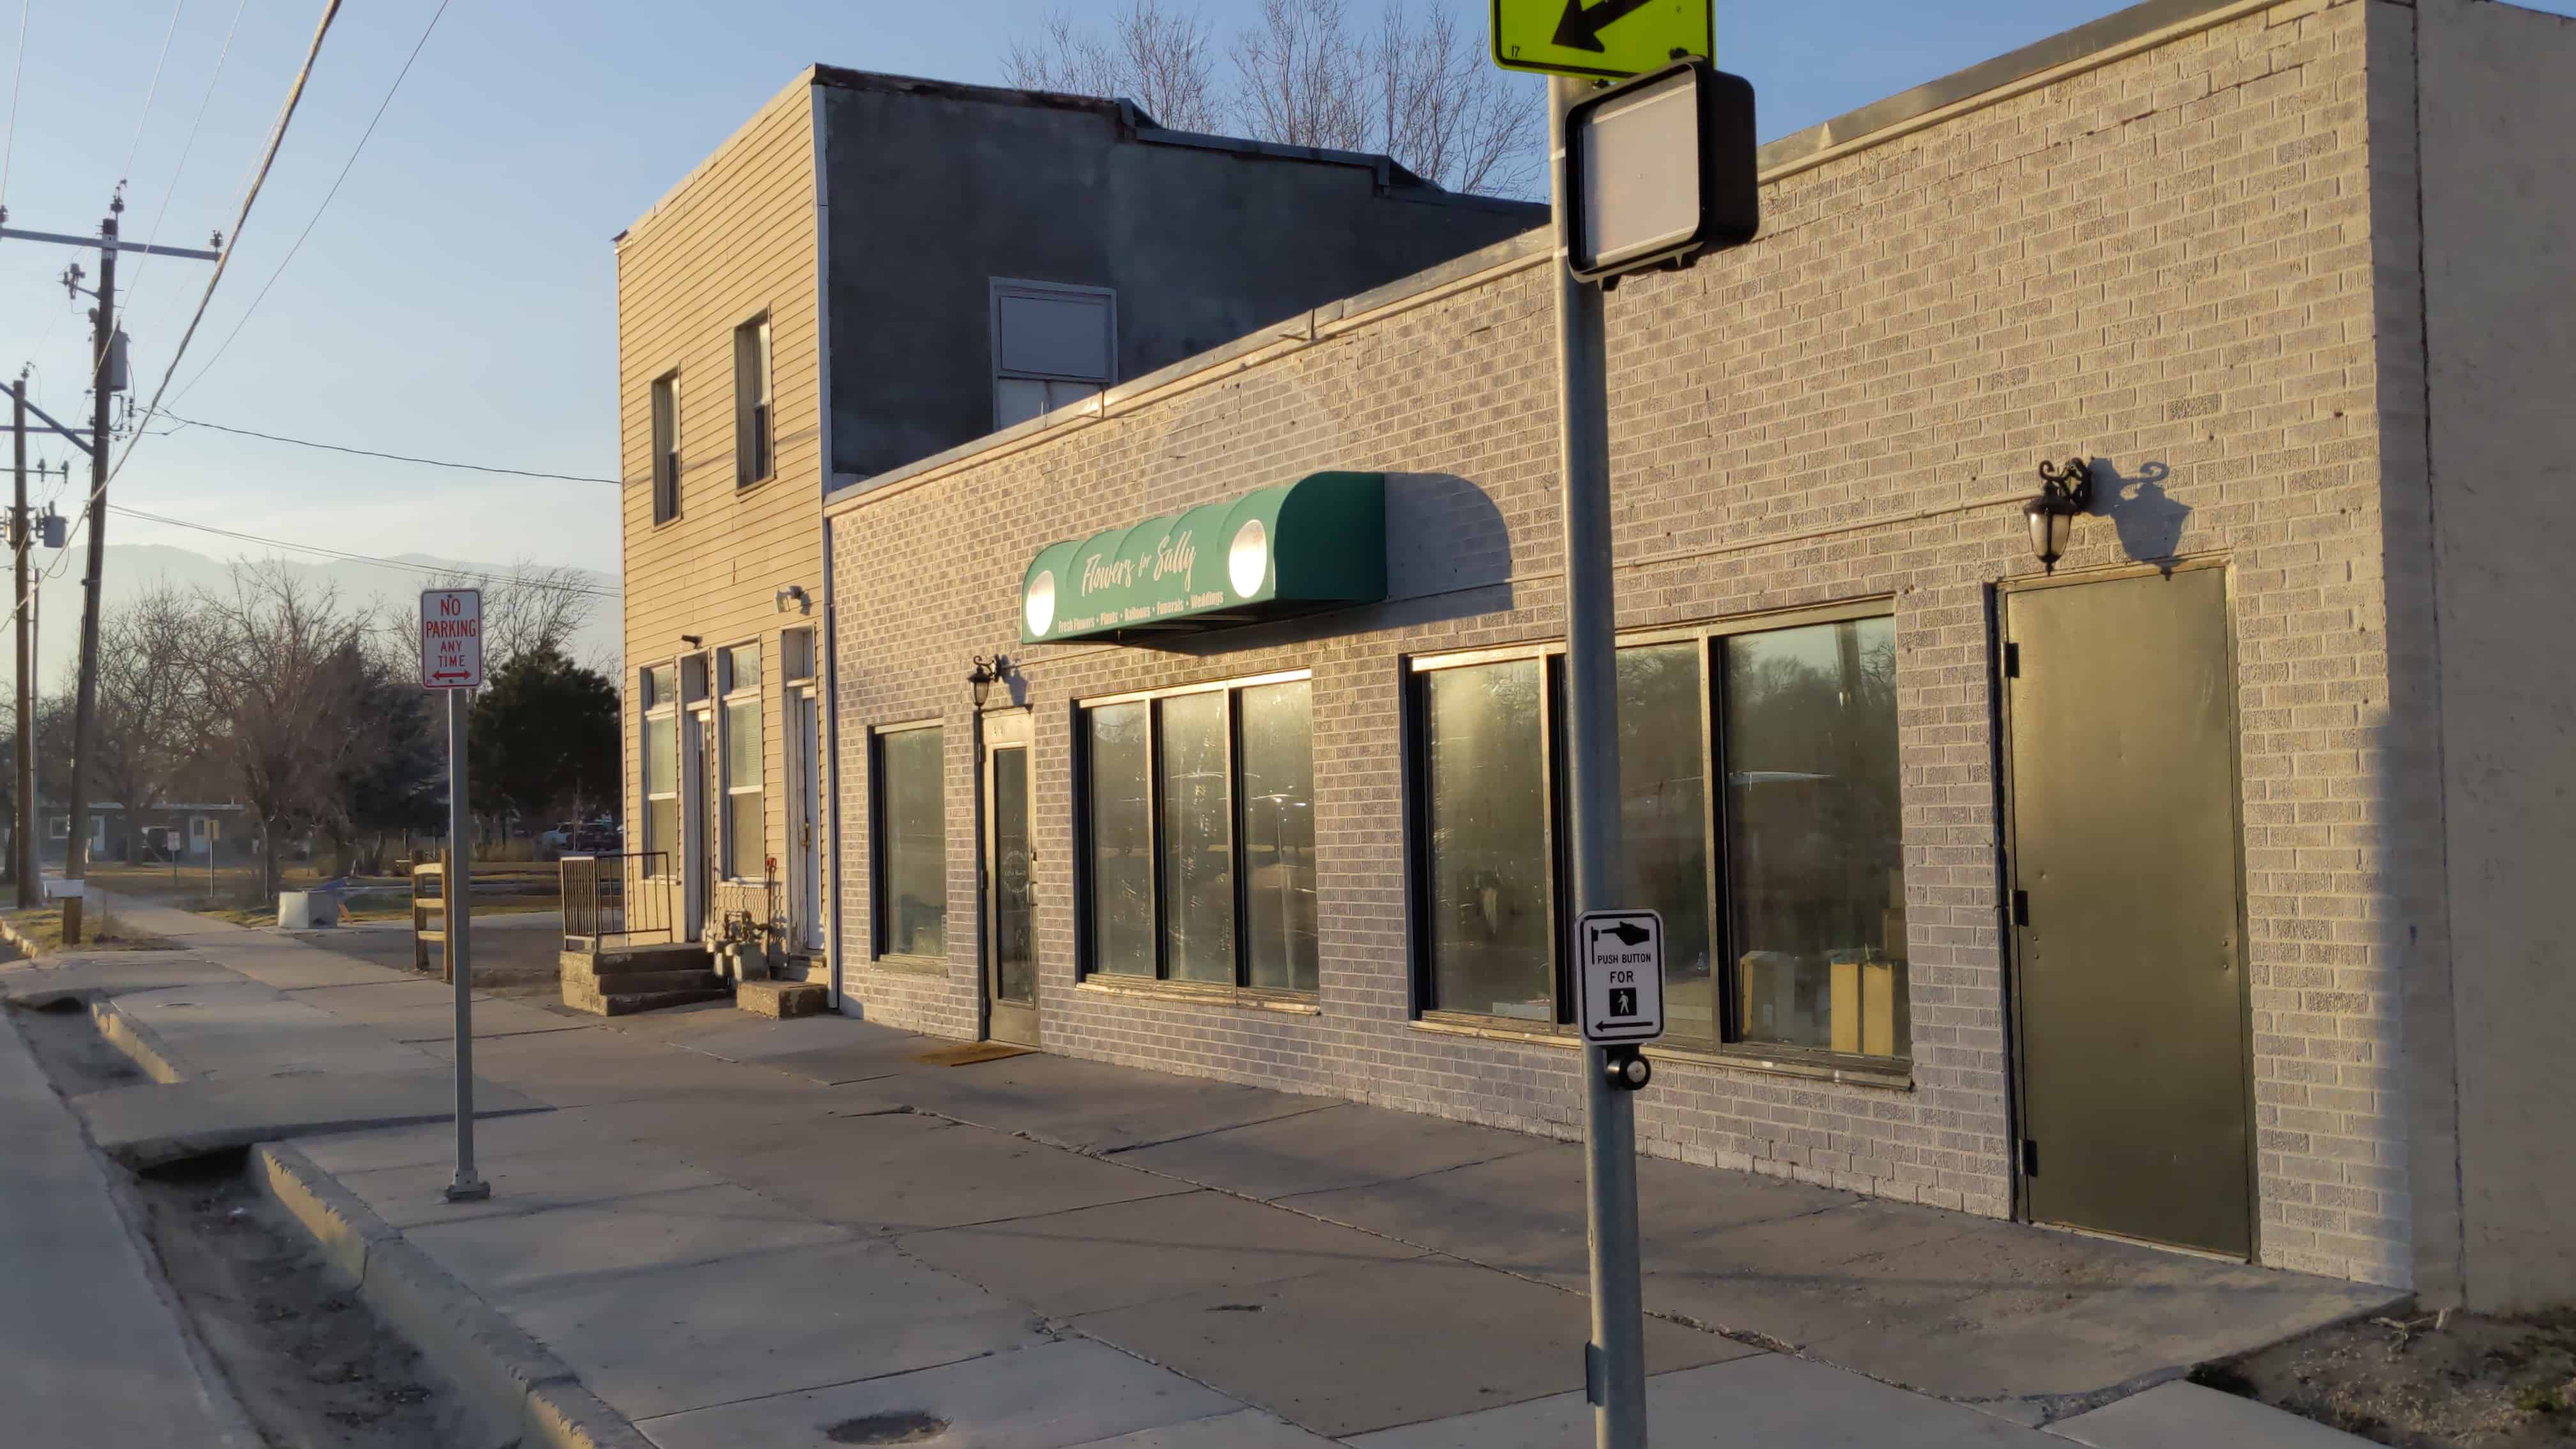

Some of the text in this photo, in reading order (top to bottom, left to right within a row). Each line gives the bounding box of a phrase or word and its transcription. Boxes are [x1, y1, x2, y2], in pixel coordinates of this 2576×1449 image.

[1511, 45, 1520, 58] 17
[1082, 530, 1196, 597] Flowers for Sally
[440, 598, 461, 617] NO
[1058, 590, 1224, 634] Fresh Flowers Plants Balloons Funerals Weddings
[426, 619, 476, 638] PARKING
[440, 640, 462, 652] ANY
[438, 655, 466, 668] TIME
[1597, 953, 1651, 965] PUSH BUTTON
[1610, 970, 1634, 984] FOR
